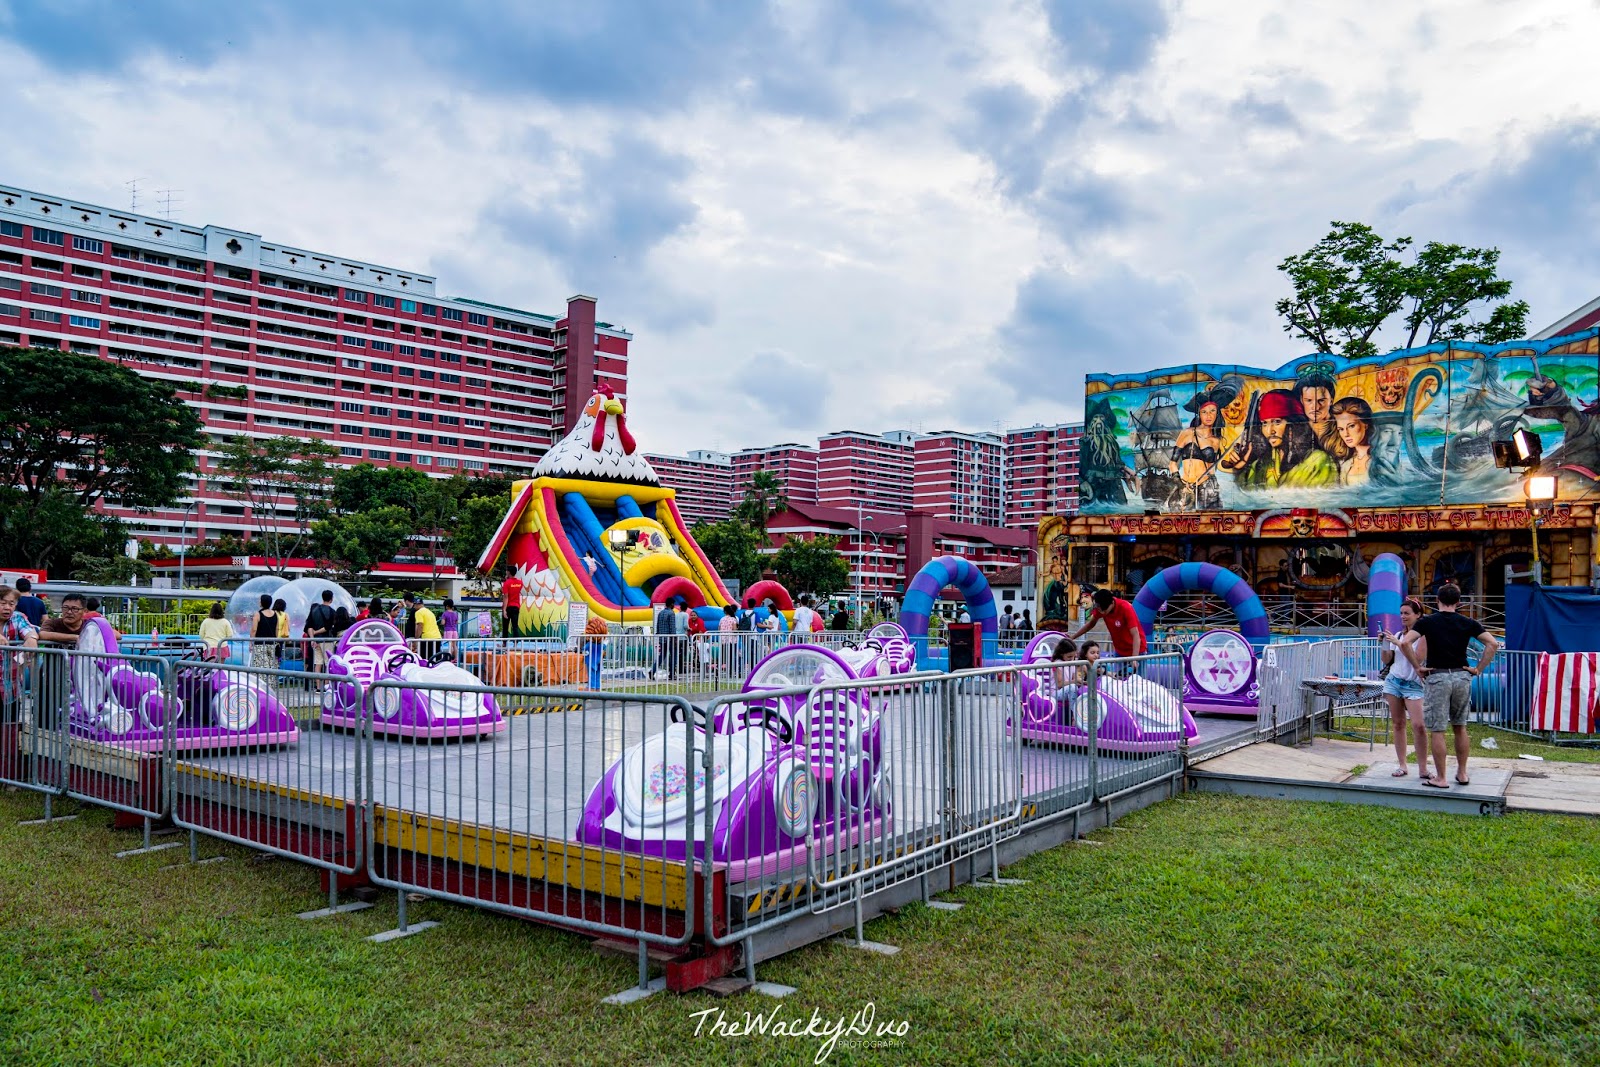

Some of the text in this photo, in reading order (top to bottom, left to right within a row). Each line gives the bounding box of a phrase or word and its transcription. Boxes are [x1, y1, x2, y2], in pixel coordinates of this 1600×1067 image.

[1109, 516, 1256, 533] WELCOME TO A
[1348, 507, 1570, 529] JOURNEY OF THRILS
